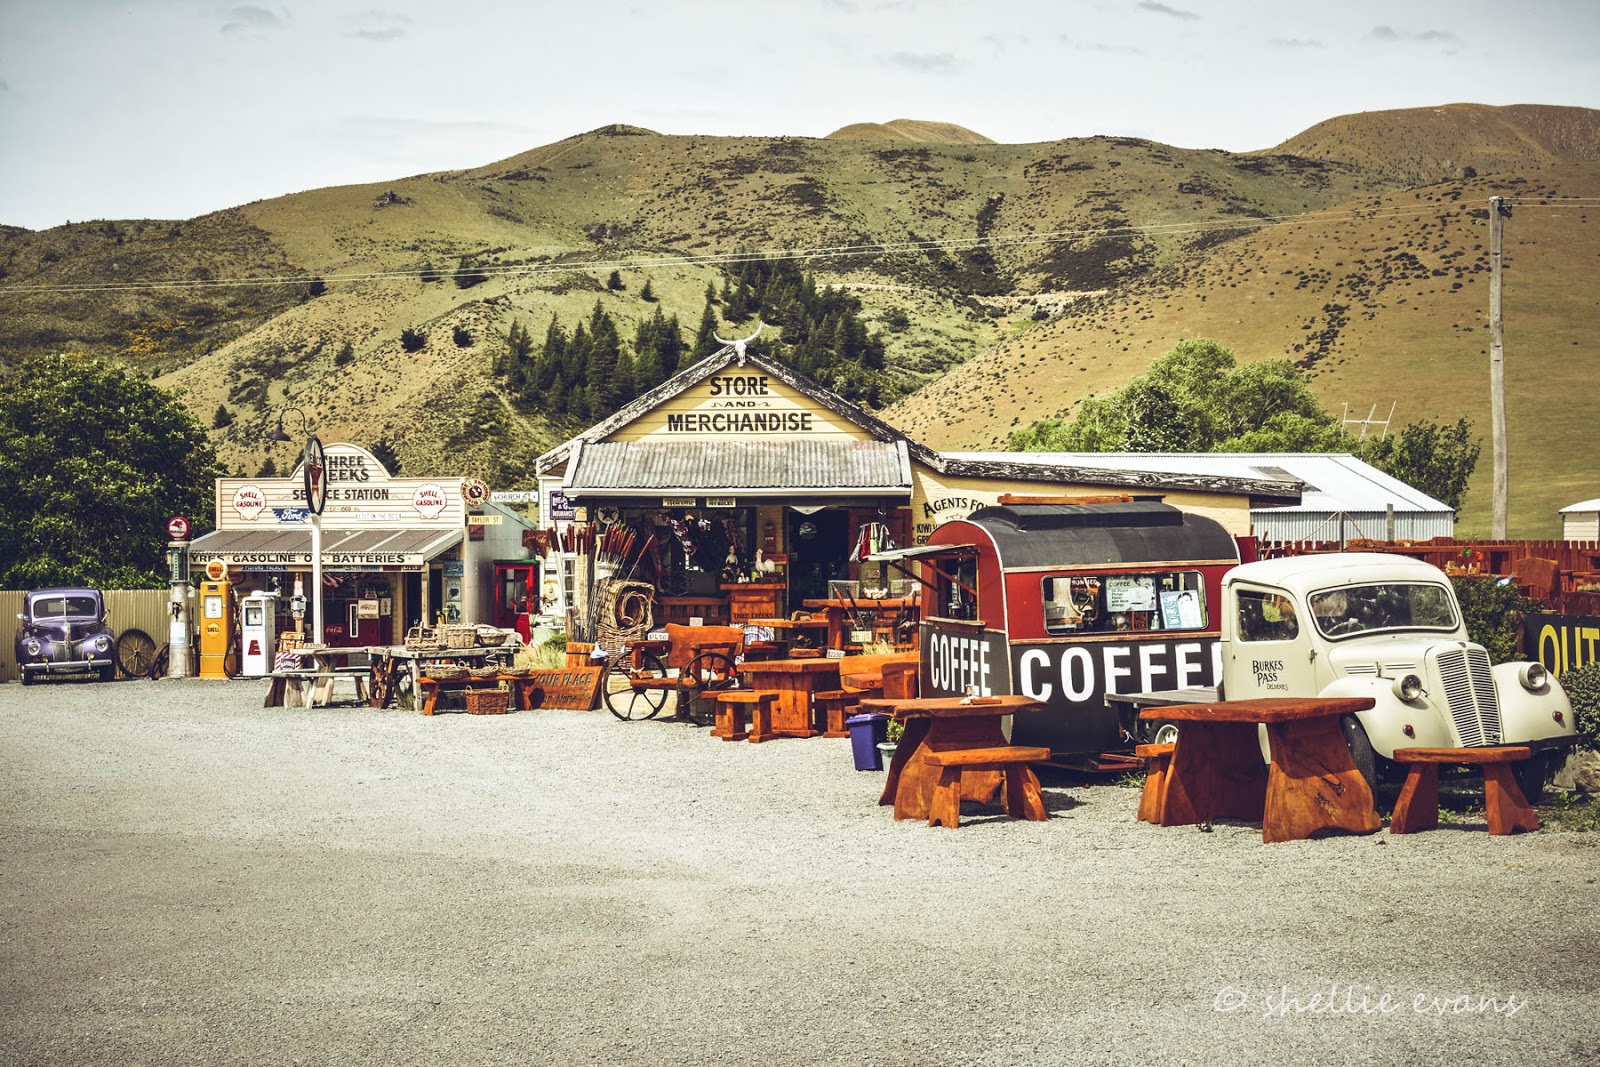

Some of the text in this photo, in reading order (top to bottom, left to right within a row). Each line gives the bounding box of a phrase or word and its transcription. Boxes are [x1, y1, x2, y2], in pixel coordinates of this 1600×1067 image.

[709, 376, 769, 396] STORE
[667, 412, 813, 432] MERCHANDISE
[325, 455, 365, 468] HREE
[326, 468, 370, 485] EEKS
[292, 488, 389, 501] SECE STATION
[419, 490, 438, 498] SHELL
[235, 500, 263, 508] GASOLINE
[923, 497, 989, 519] AGENTS FO
[281, 509, 303, 520] Ford
[916, 524, 932, 533] KIWI
[191, 554, 225, 562] YRES
[232, 554, 297, 563] GASOLINE
[332, 554, 405, 563] BATTERIES
[1538, 624, 1600, 679] OUT
[930, 633, 992, 698] COFFEE
[1252, 660, 1283, 673] BURKES
[562, 672, 594, 686] PLACE
[1257, 672, 1278, 687] PASS
[1266, 683, 1289, 691] DELIVERIES
